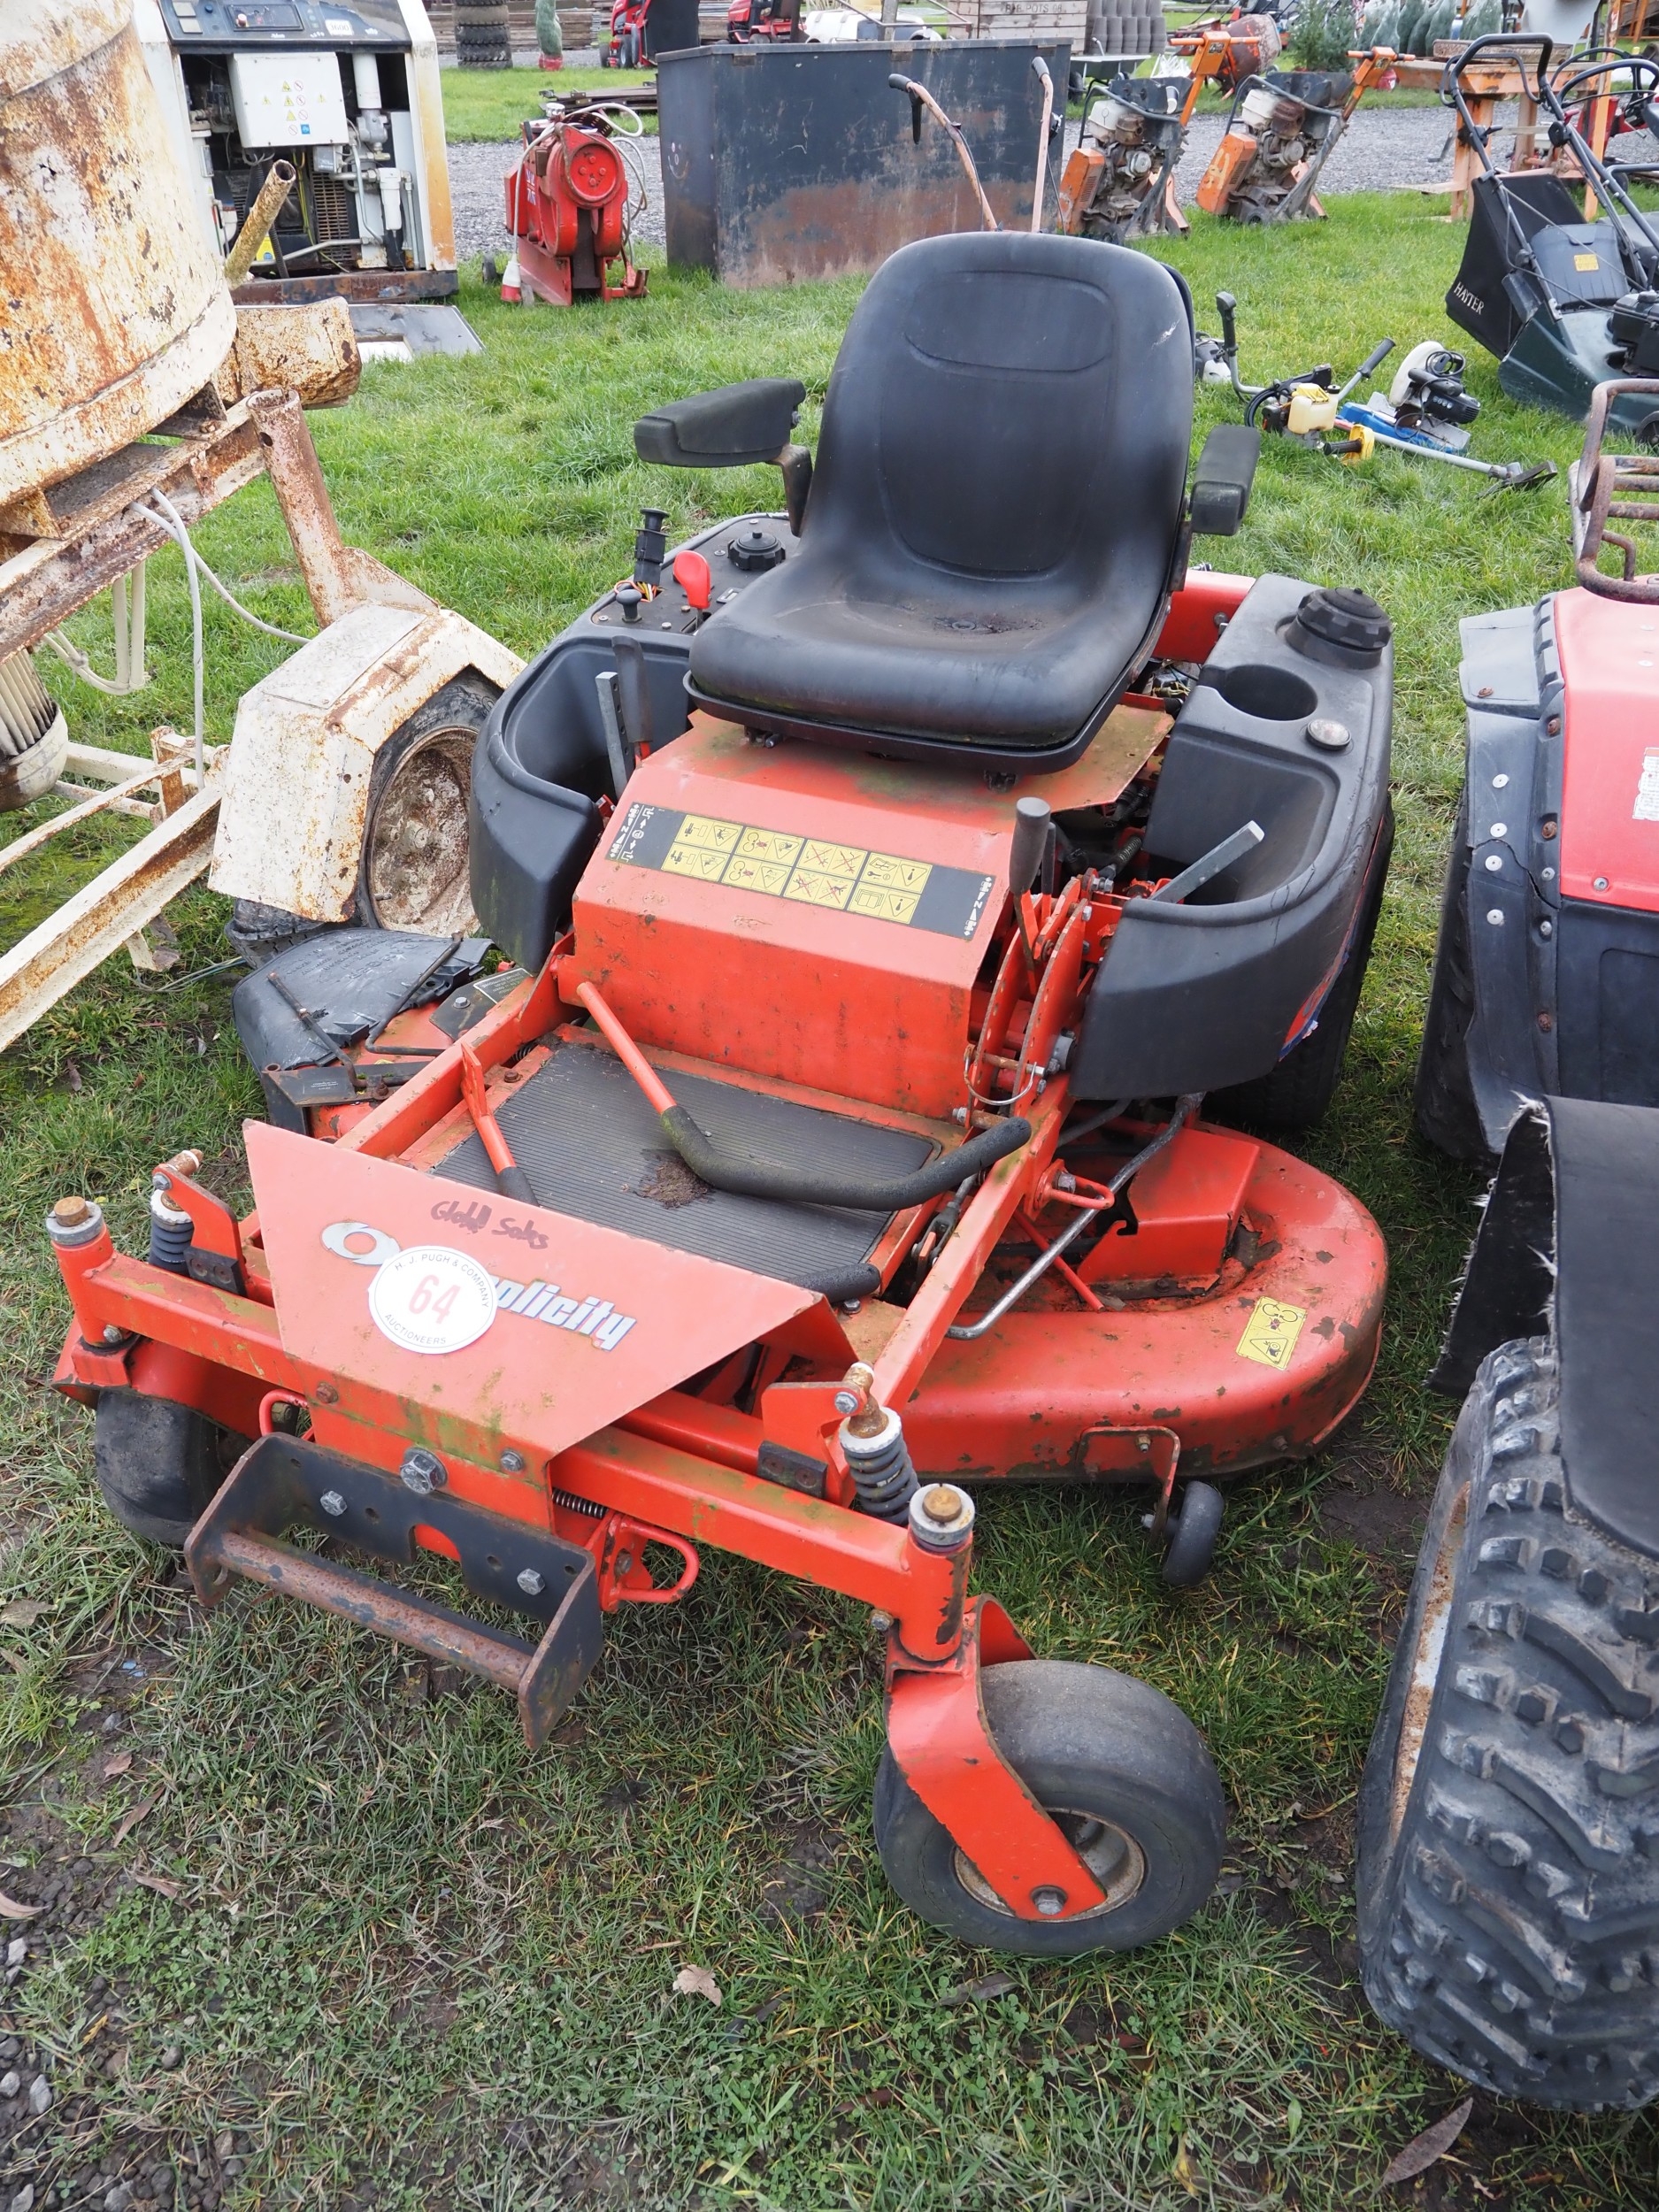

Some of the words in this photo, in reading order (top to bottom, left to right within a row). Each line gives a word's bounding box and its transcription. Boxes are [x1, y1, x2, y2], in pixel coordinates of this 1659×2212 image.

[1026, 4, 1049, 13] POTS
[1453, 281, 1485, 315] HAYTER
[395, 1262, 406, 1271] H.
[421, 1253, 451, 1264] PUGH
[461, 1263, 489, 1308] COMPANY
[408, 1274, 461, 1325] 64
[385, 1313, 446, 1345] AUCTIONEERS
[491, 1275, 637, 1351] plicity
